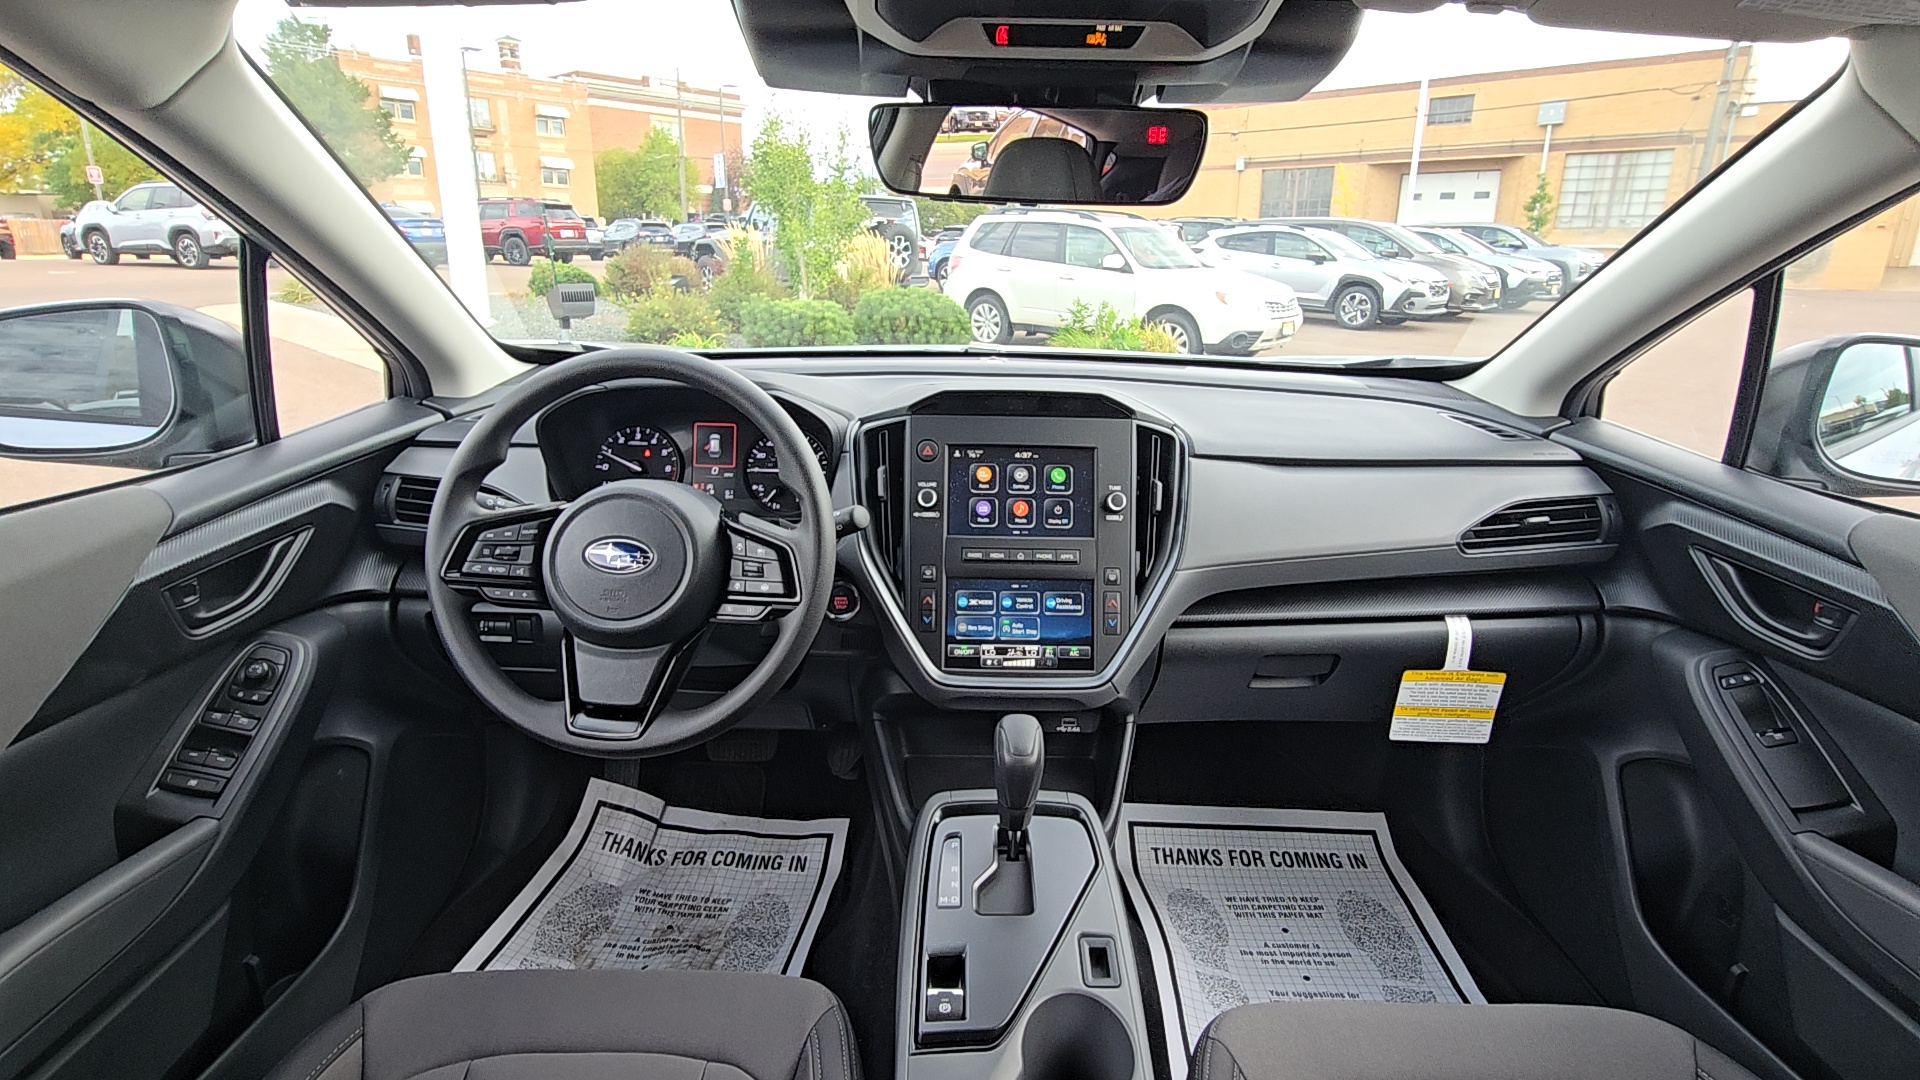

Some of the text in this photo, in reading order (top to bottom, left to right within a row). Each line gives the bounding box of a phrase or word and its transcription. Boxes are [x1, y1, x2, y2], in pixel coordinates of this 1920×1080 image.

[601, 830, 808, 872] THANKS FOR COMING IN
[1150, 847, 1368, 869] THANKS FOR COMING IN
[635, 895, 656, 905] YOUR
[658, 901, 703, 912] CARPETING
[639, 888, 651, 896] WE
[652, 891, 673, 900] HAVE
[675, 894, 698, 902] TRIED
[634, 905, 656, 914] WITH
[657, 907, 675, 917] THIS
